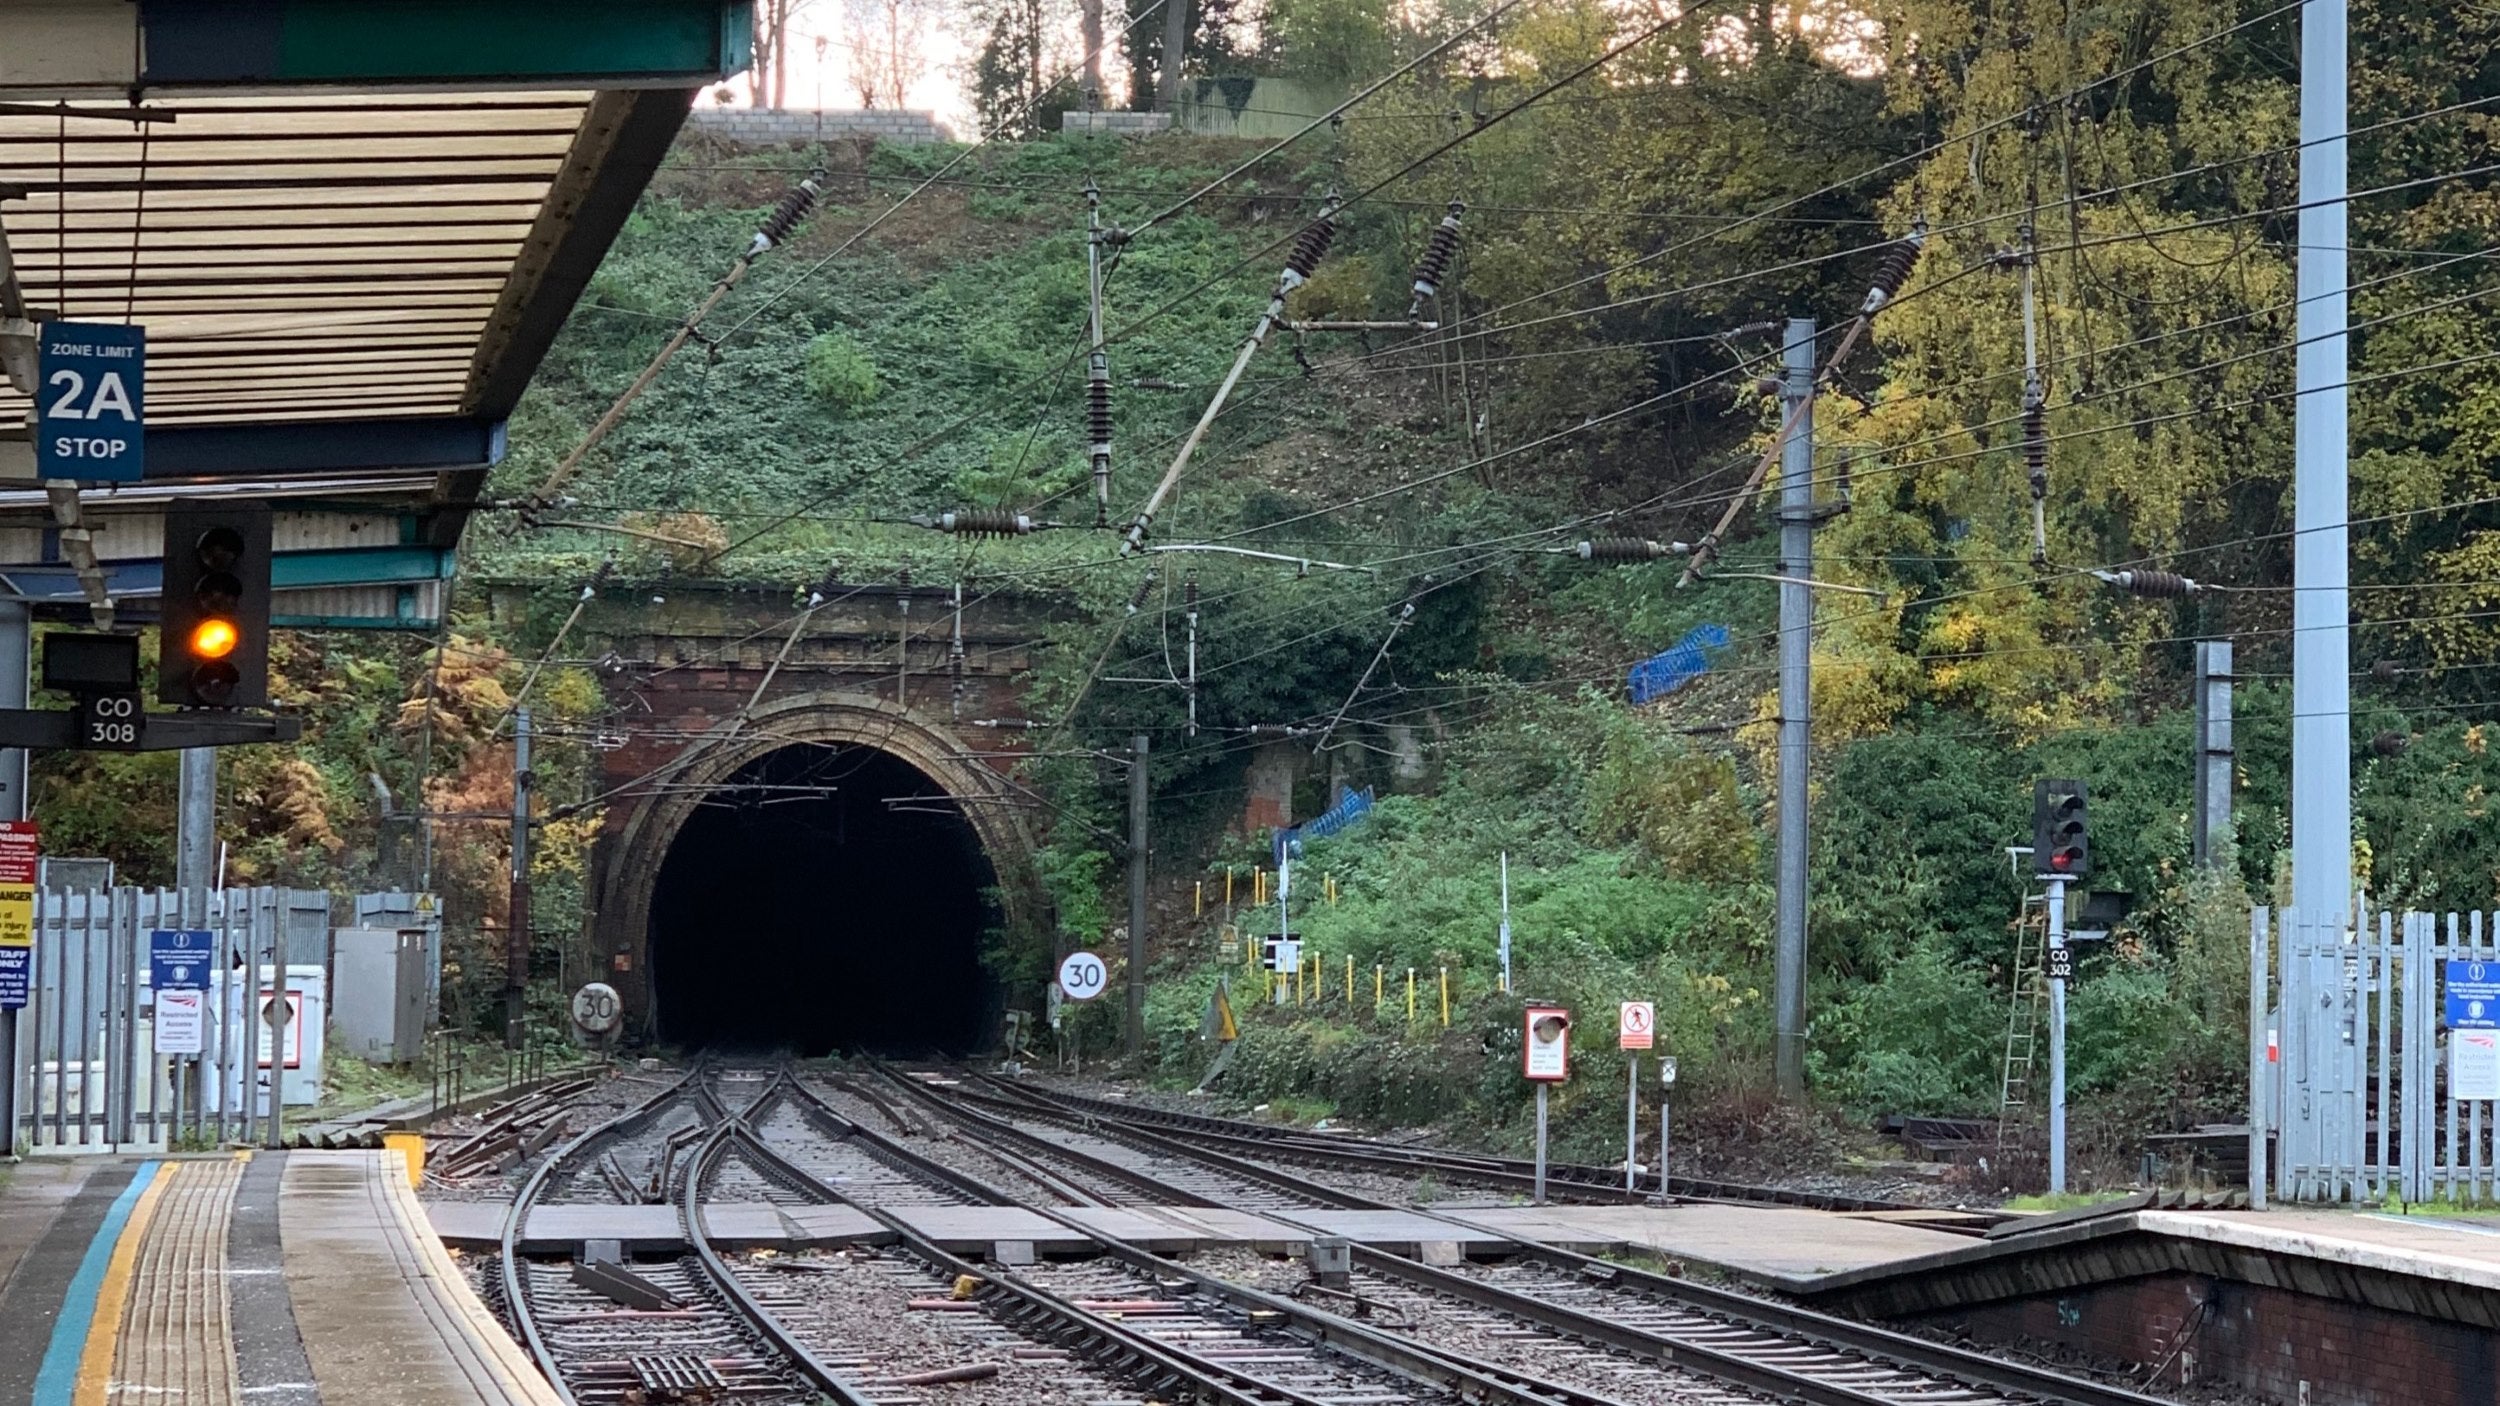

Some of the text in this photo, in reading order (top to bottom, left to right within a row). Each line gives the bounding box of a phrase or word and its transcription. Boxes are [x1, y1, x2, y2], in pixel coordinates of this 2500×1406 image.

[51, 343, 135, 358] ZONE LIMIT
[48, 369, 137, 421] 2A
[55, 437, 127, 459] STOP
[96, 697, 132, 717] CO
[91, 722, 135, 743] 308
[2051, 949, 2069, 962] CO
[1069, 963, 1100, 988] 30
[2050, 963, 2071, 976] 302
[580, 994, 613, 1019] 30
